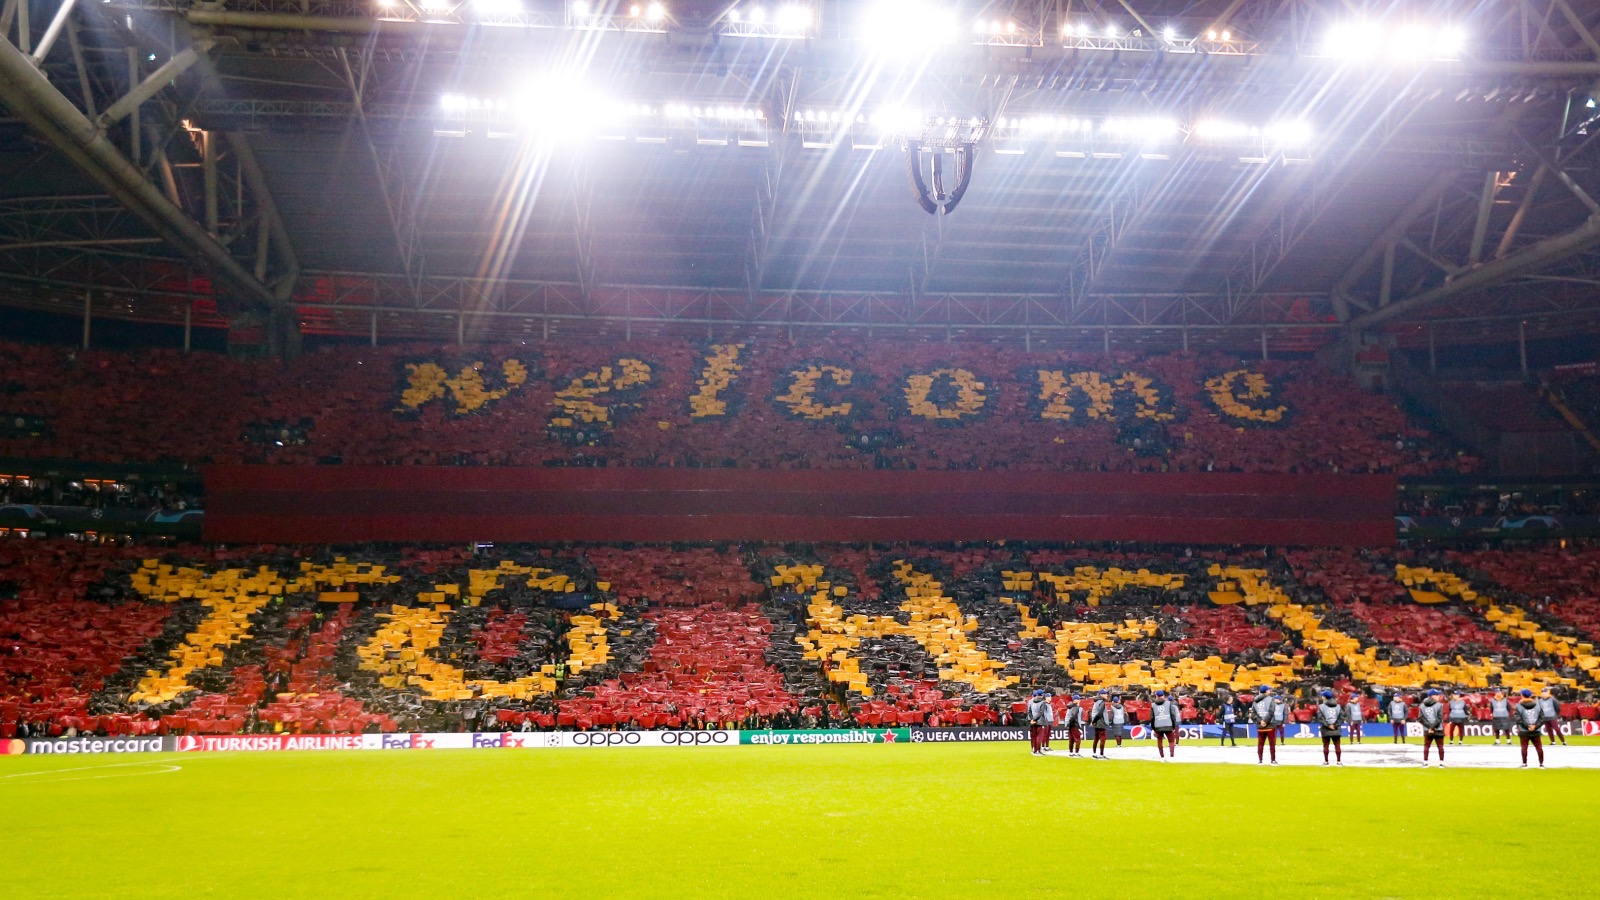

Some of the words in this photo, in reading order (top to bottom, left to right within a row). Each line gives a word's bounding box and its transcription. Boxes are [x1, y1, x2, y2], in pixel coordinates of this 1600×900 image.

[206, 736, 281, 751] TURKISH
[284, 736, 363, 750] AIRLINES
[382, 733, 436, 749] FedEx
[472, 732, 526, 749] FedEx
[573, 732, 642, 747] oppo
[661, 731, 729, 746] oppo
[751, 731, 791, 745] enjoy
[793, 730, 877, 745] responsibly
[926, 731, 957, 742] UEFA
[958, 730, 1023, 741] CHAMPIONS
[31, 737, 164, 753] mastercard
